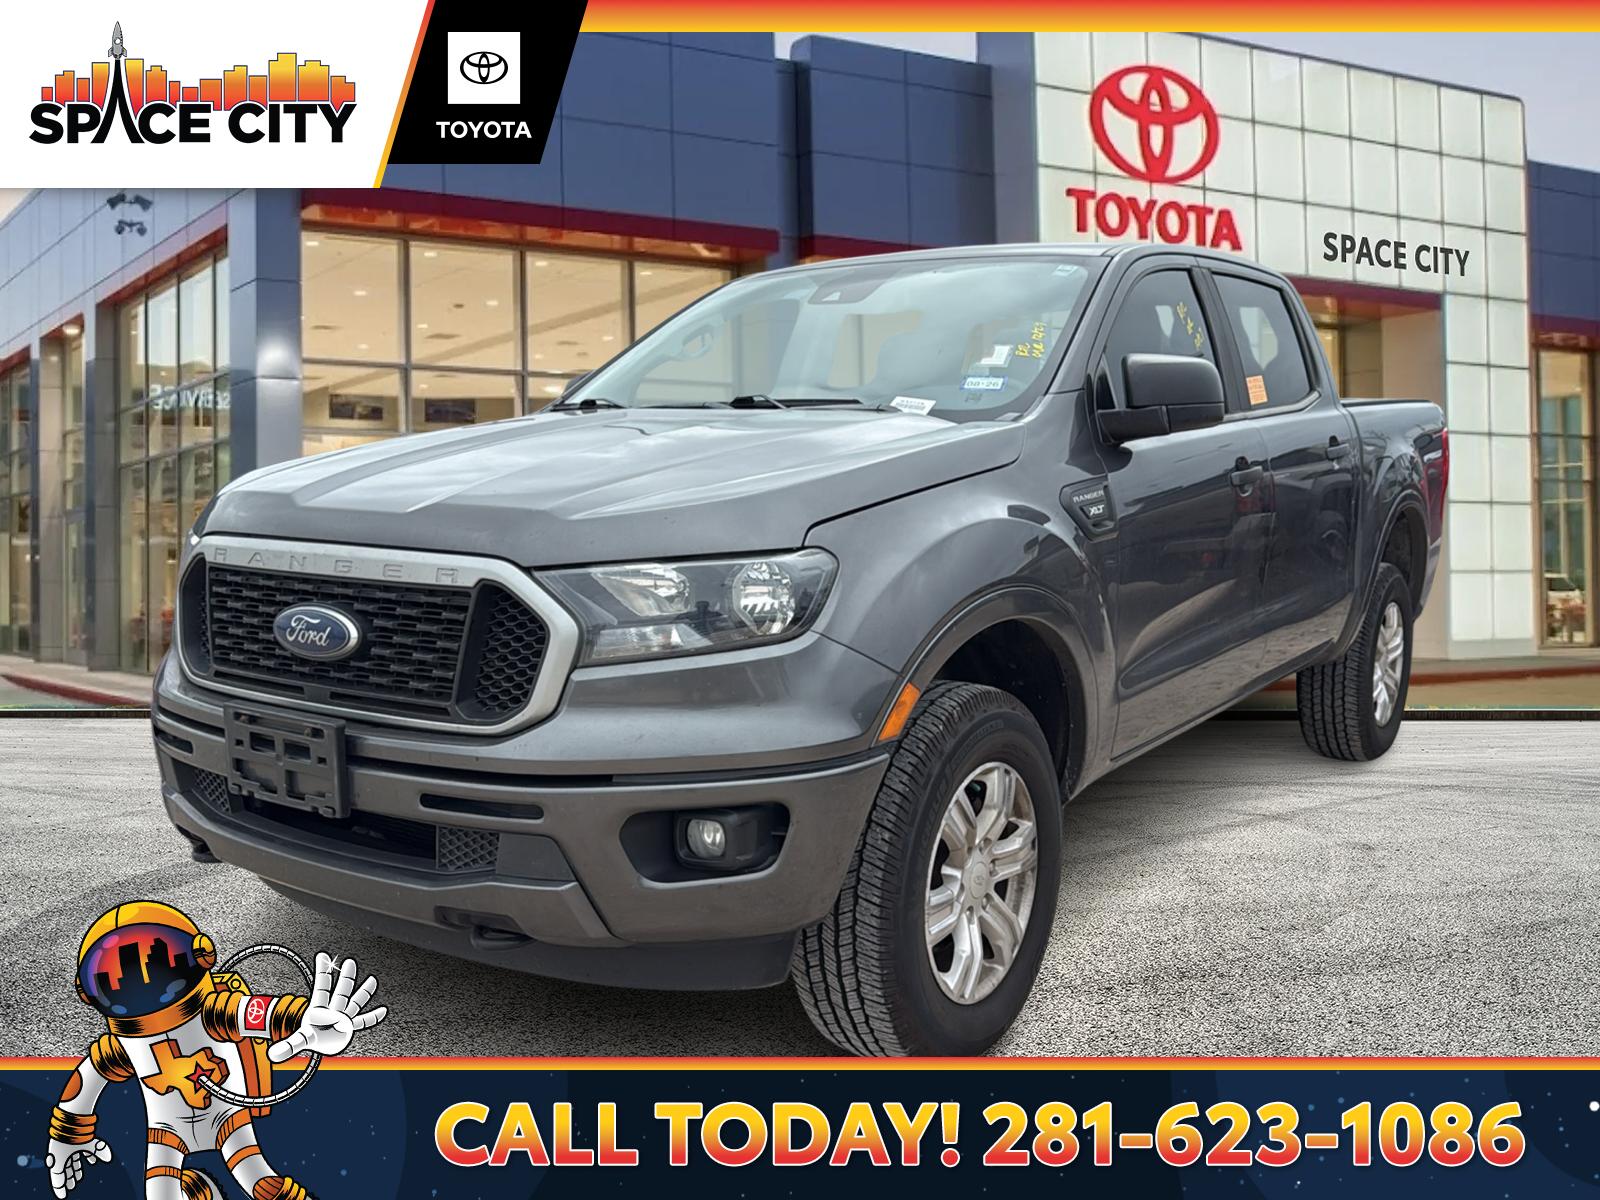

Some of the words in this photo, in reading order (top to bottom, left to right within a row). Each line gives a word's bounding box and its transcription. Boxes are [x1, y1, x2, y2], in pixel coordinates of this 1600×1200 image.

[1066, 187, 1243, 252] TOYOTA
[1322, 232, 1407, 270] SPACE
[1414, 244, 1470, 277] CITY
[1089, 505, 1104, 516] XLT
[213, 547, 459, 583] RANGER
[285, 614, 330, 648] Ford
